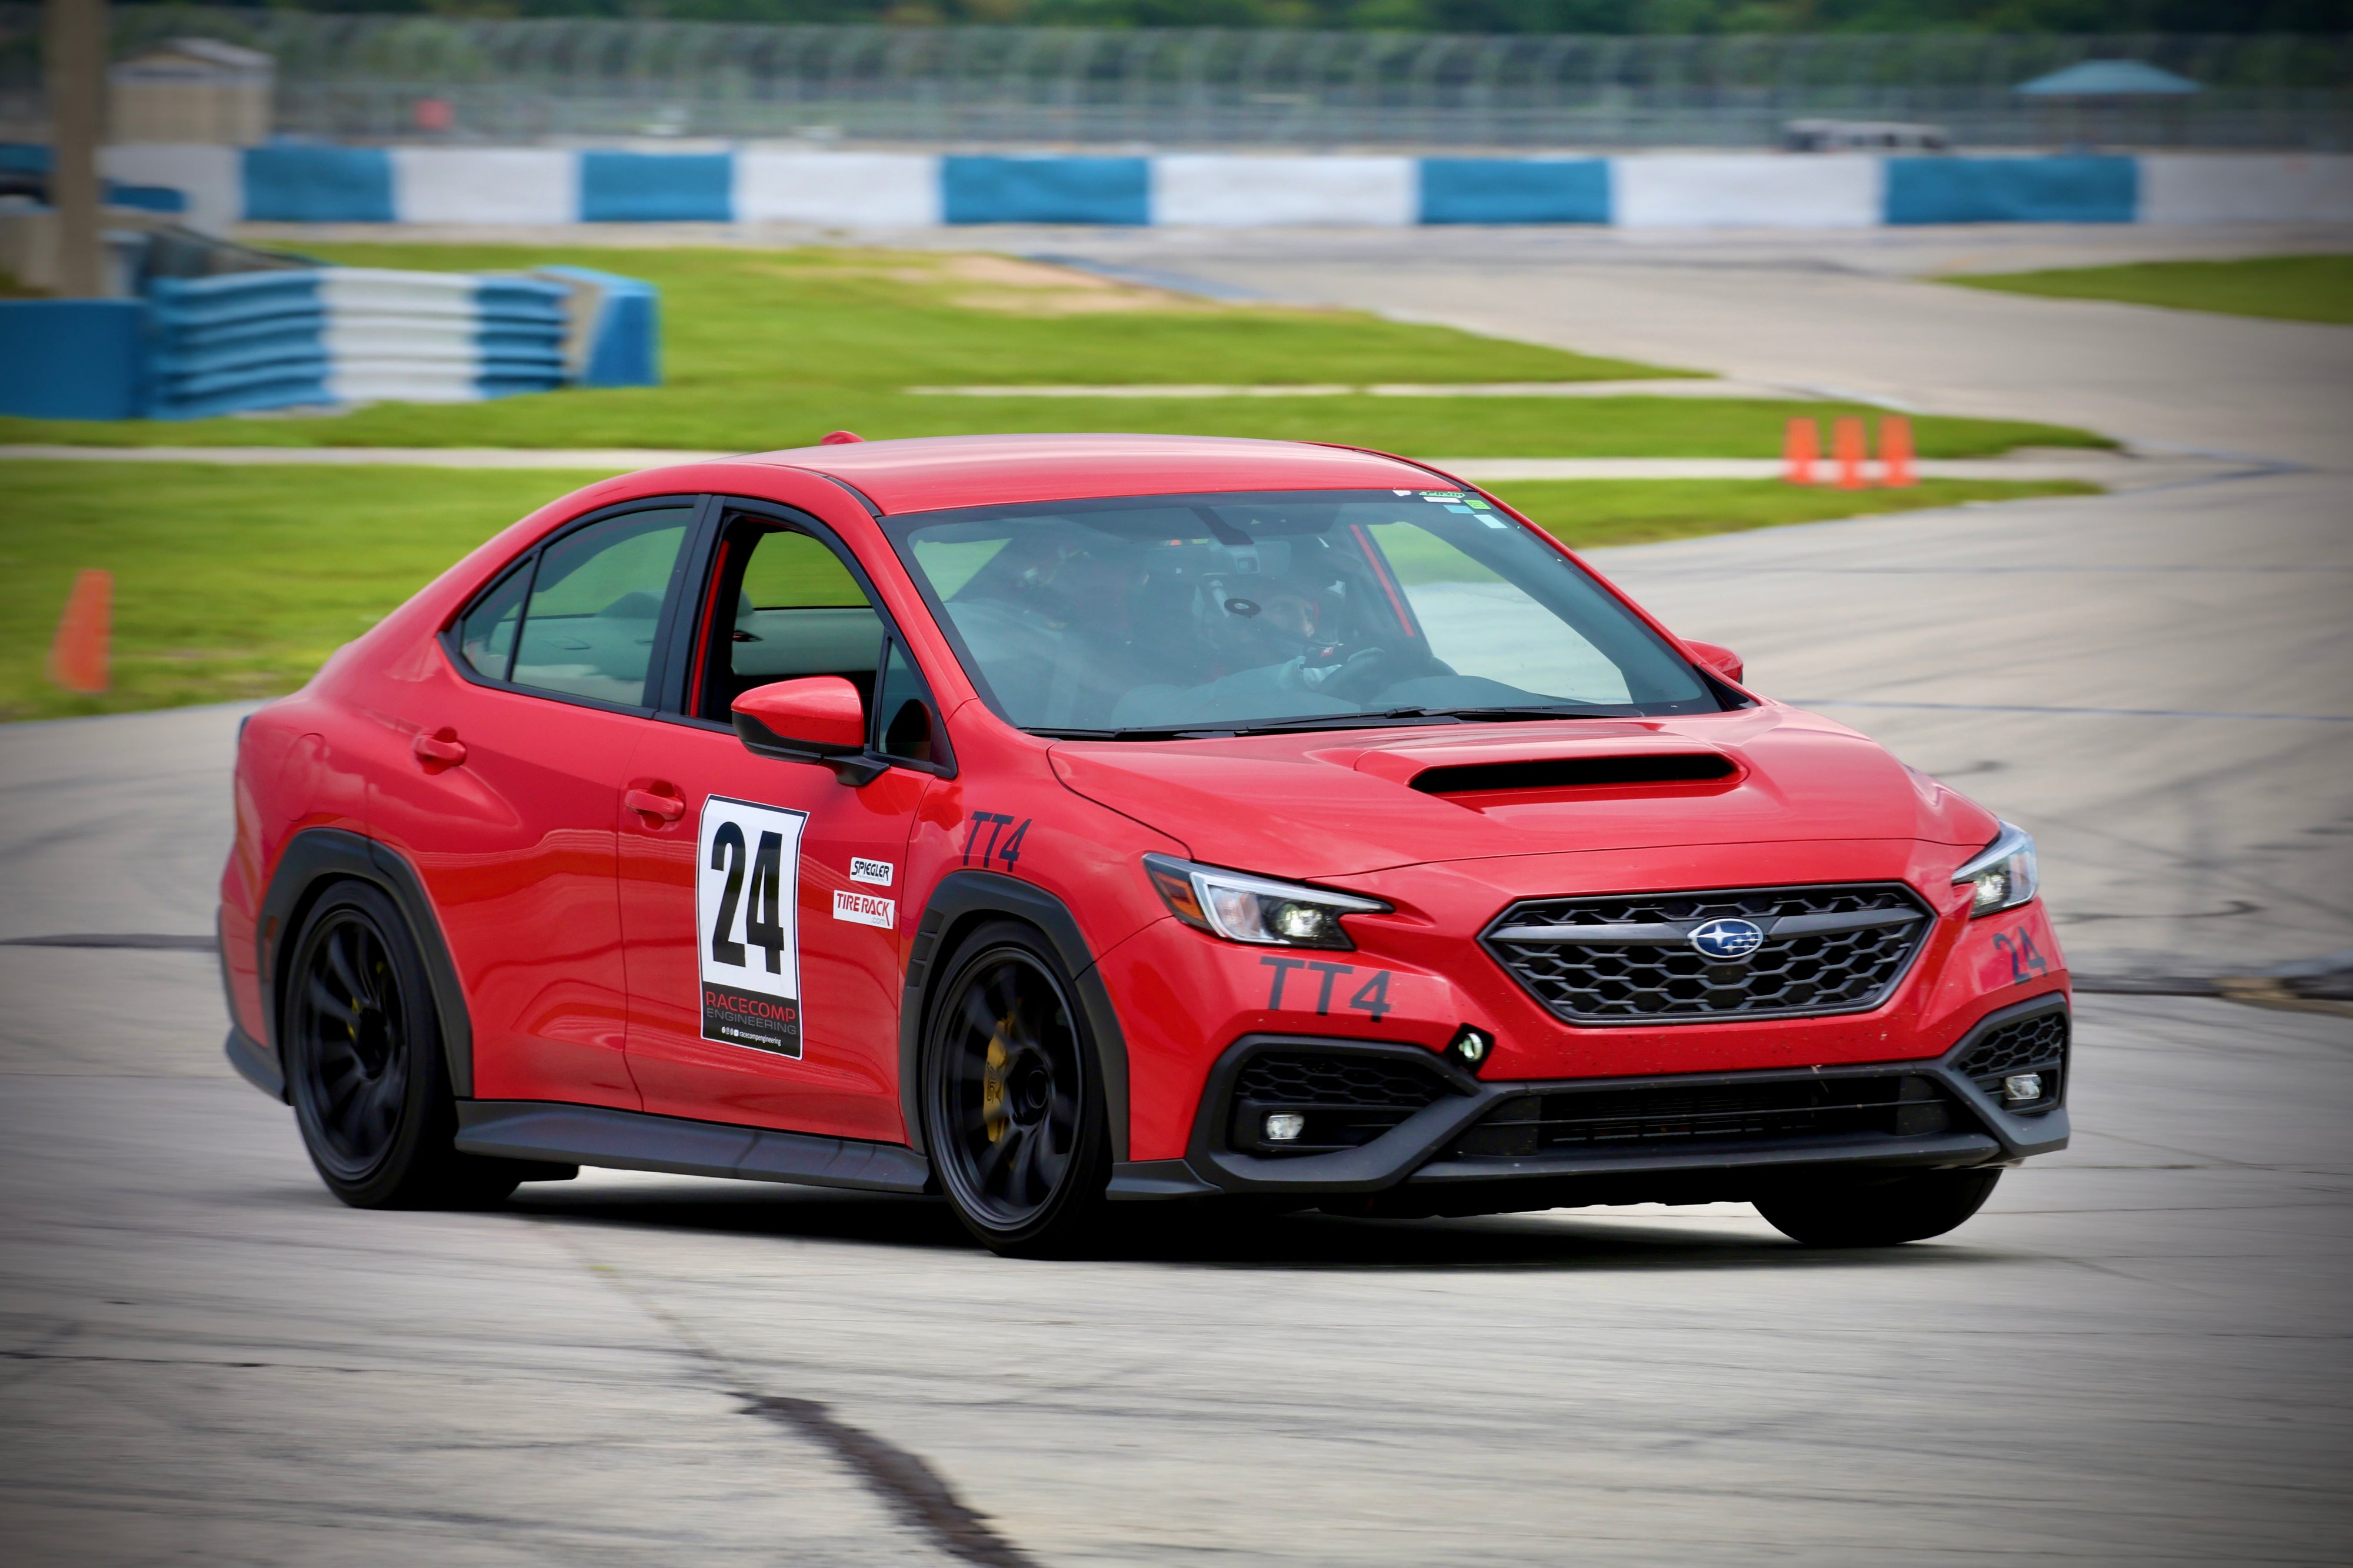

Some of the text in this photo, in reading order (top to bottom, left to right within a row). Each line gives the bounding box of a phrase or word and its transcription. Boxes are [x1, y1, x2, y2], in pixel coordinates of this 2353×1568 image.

[964, 810, 1032, 872] TT4
[851, 860, 889, 881] SPIEGLER
[711, 821, 784, 975] 24
[837, 893, 890, 926] TIRE RACK
[1992, 926, 2048, 986] 24
[1260, 956, 1391, 1023] TT4
[706, 991, 795, 1022] RACECOMP
[706, 1007, 796, 1035] ENGINEERING
[739, 1031, 781, 1046] racecompengineering
